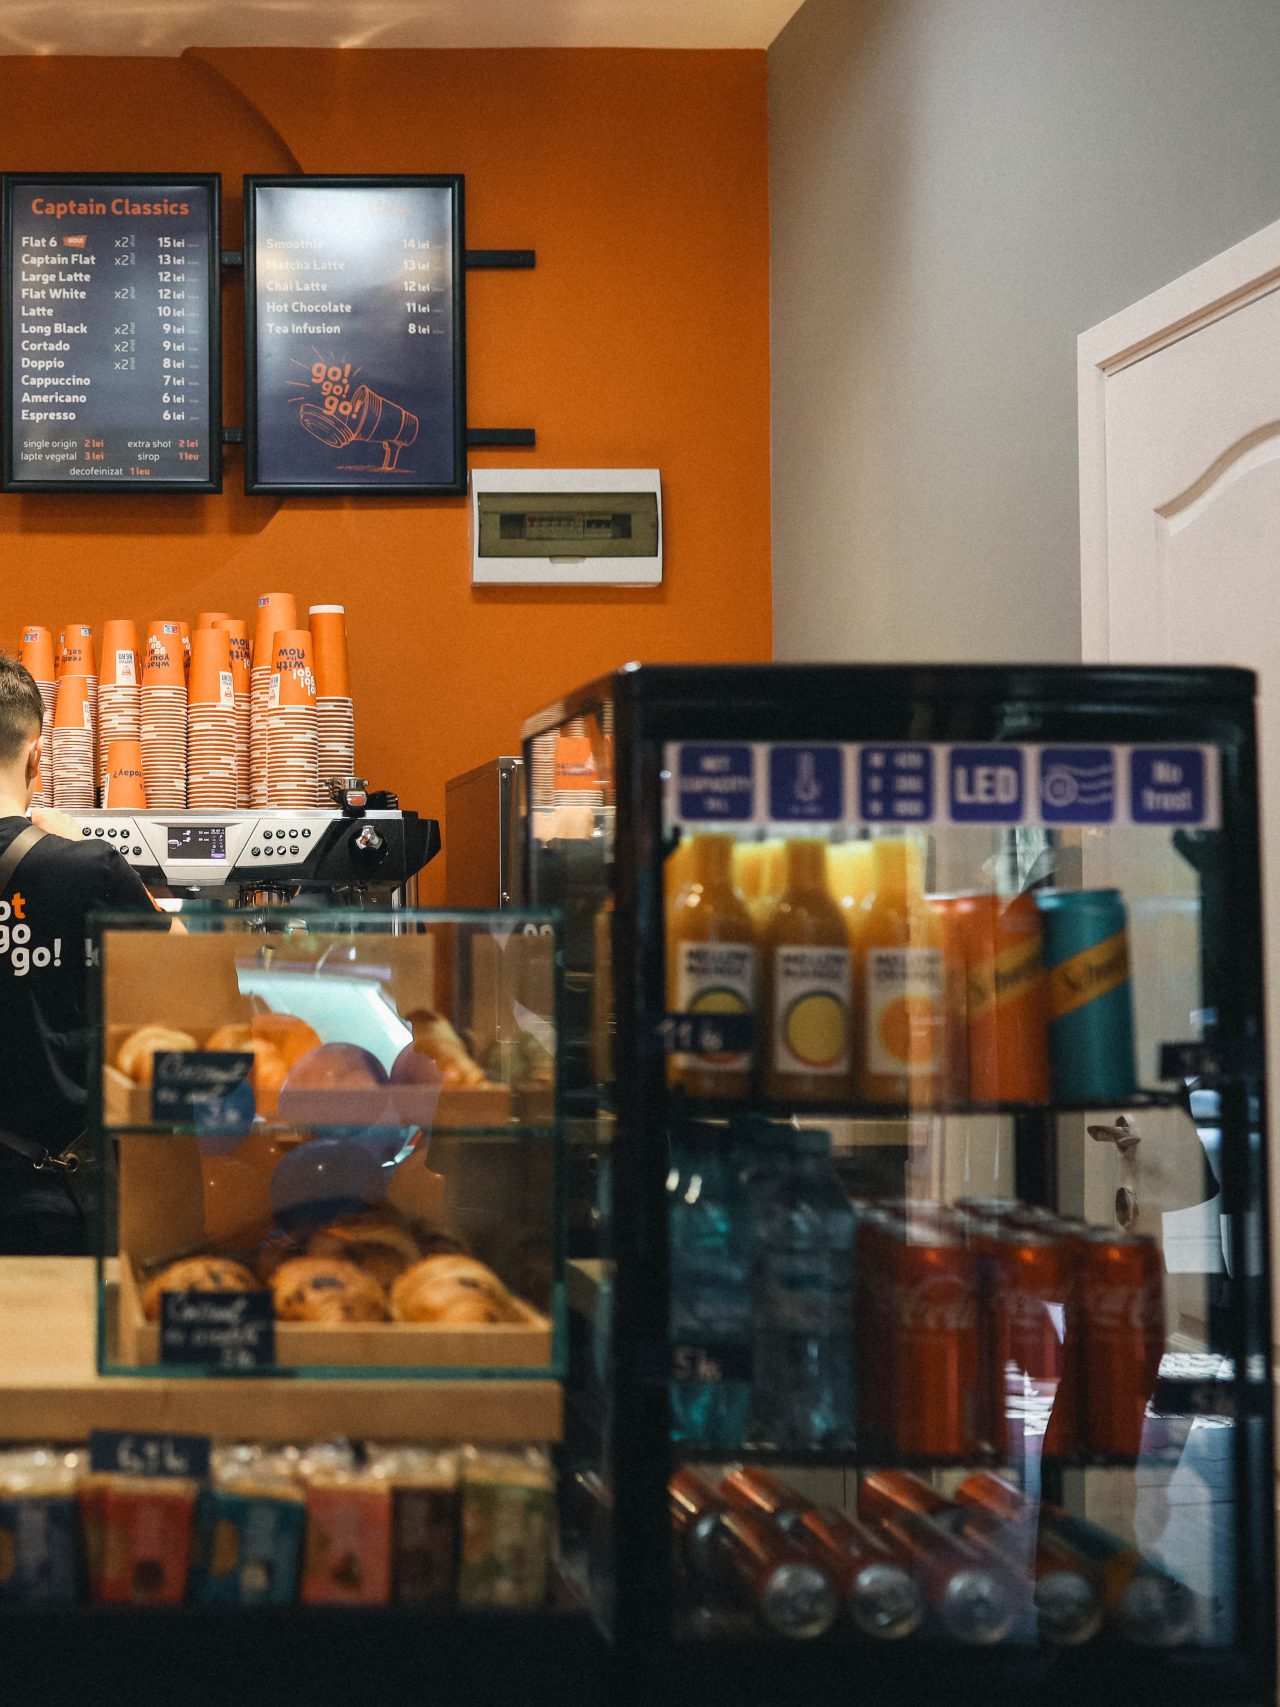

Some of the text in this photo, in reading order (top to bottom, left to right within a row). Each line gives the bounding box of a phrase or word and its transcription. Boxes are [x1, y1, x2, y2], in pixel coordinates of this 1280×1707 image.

[32, 198, 190, 219] Captain Classics
[22, 237, 47, 248] Flat
[49, 237, 58, 248] 6
[114, 237, 129, 248] x2
[158, 237, 185, 248] 15 lei
[22, 254, 96, 267] Captain Flat
[114, 255, 129, 266] x2
[158, 254, 185, 265] 13 lei
[313, 260, 345, 271] Latte
[404, 260, 416, 271] 13
[22, 271, 91, 284] Large Latte
[158, 271, 185, 282] 12 lei
[266, 281, 327, 291] Chai Latte
[403, 281, 430, 291] 12 lei
[21, 288, 87, 299] Flat White
[114, 289, 129, 299] x2
[158, 288, 185, 299] 12 lei
[21, 306, 53, 316] Latte
[157, 306, 185, 316] 10 lei
[266, 302, 352, 313] Hot Chocolate
[406, 302, 430, 313] 11 lei
[21, 323, 87, 336] Long Black
[114, 324, 129, 335] x2
[162, 323, 185, 334] 9 lei
[267, 323, 341, 334] Tea Infusion
[408, 323, 430, 334] 8 lei
[21, 340, 70, 351] Cortado
[114, 341, 129, 352] x2
[162, 340, 185, 351] 9 lei
[21, 357, 64, 370] Doppio
[114, 359, 129, 370] x2
[162, 358, 185, 368] 8 lei
[311, 362, 352, 384] go!
[21, 375, 91, 388] Cappuccino
[163, 375, 185, 386] 7 lei
[321, 381, 350, 398] go!
[21, 392, 87, 403] Americano
[162, 392, 185, 403] 6 lei
[322, 395, 363, 420] go!
[21, 410, 76, 423] Espresso
[162, 410, 185, 421] 6 lei
[23, 439, 104, 450] single origin 2 lei
[127, 439, 199, 448] extra shot 2 lei
[21, 452, 104, 463] lapte vegetal 3 lei
[137, 453, 160, 462] sirop
[184, 453, 199, 461] leu
[69, 466, 123, 476] decofeinizat
[136, 467, 150, 476] leu
[278, 648, 305, 660] flow
[276, 661, 304, 672] with
[293, 667, 311, 680] go!
[300, 676, 315, 688] go!
[1152, 760, 1184, 784] No
[954, 765, 1019, 804] LED
[11, 938, 62, 977] go!
